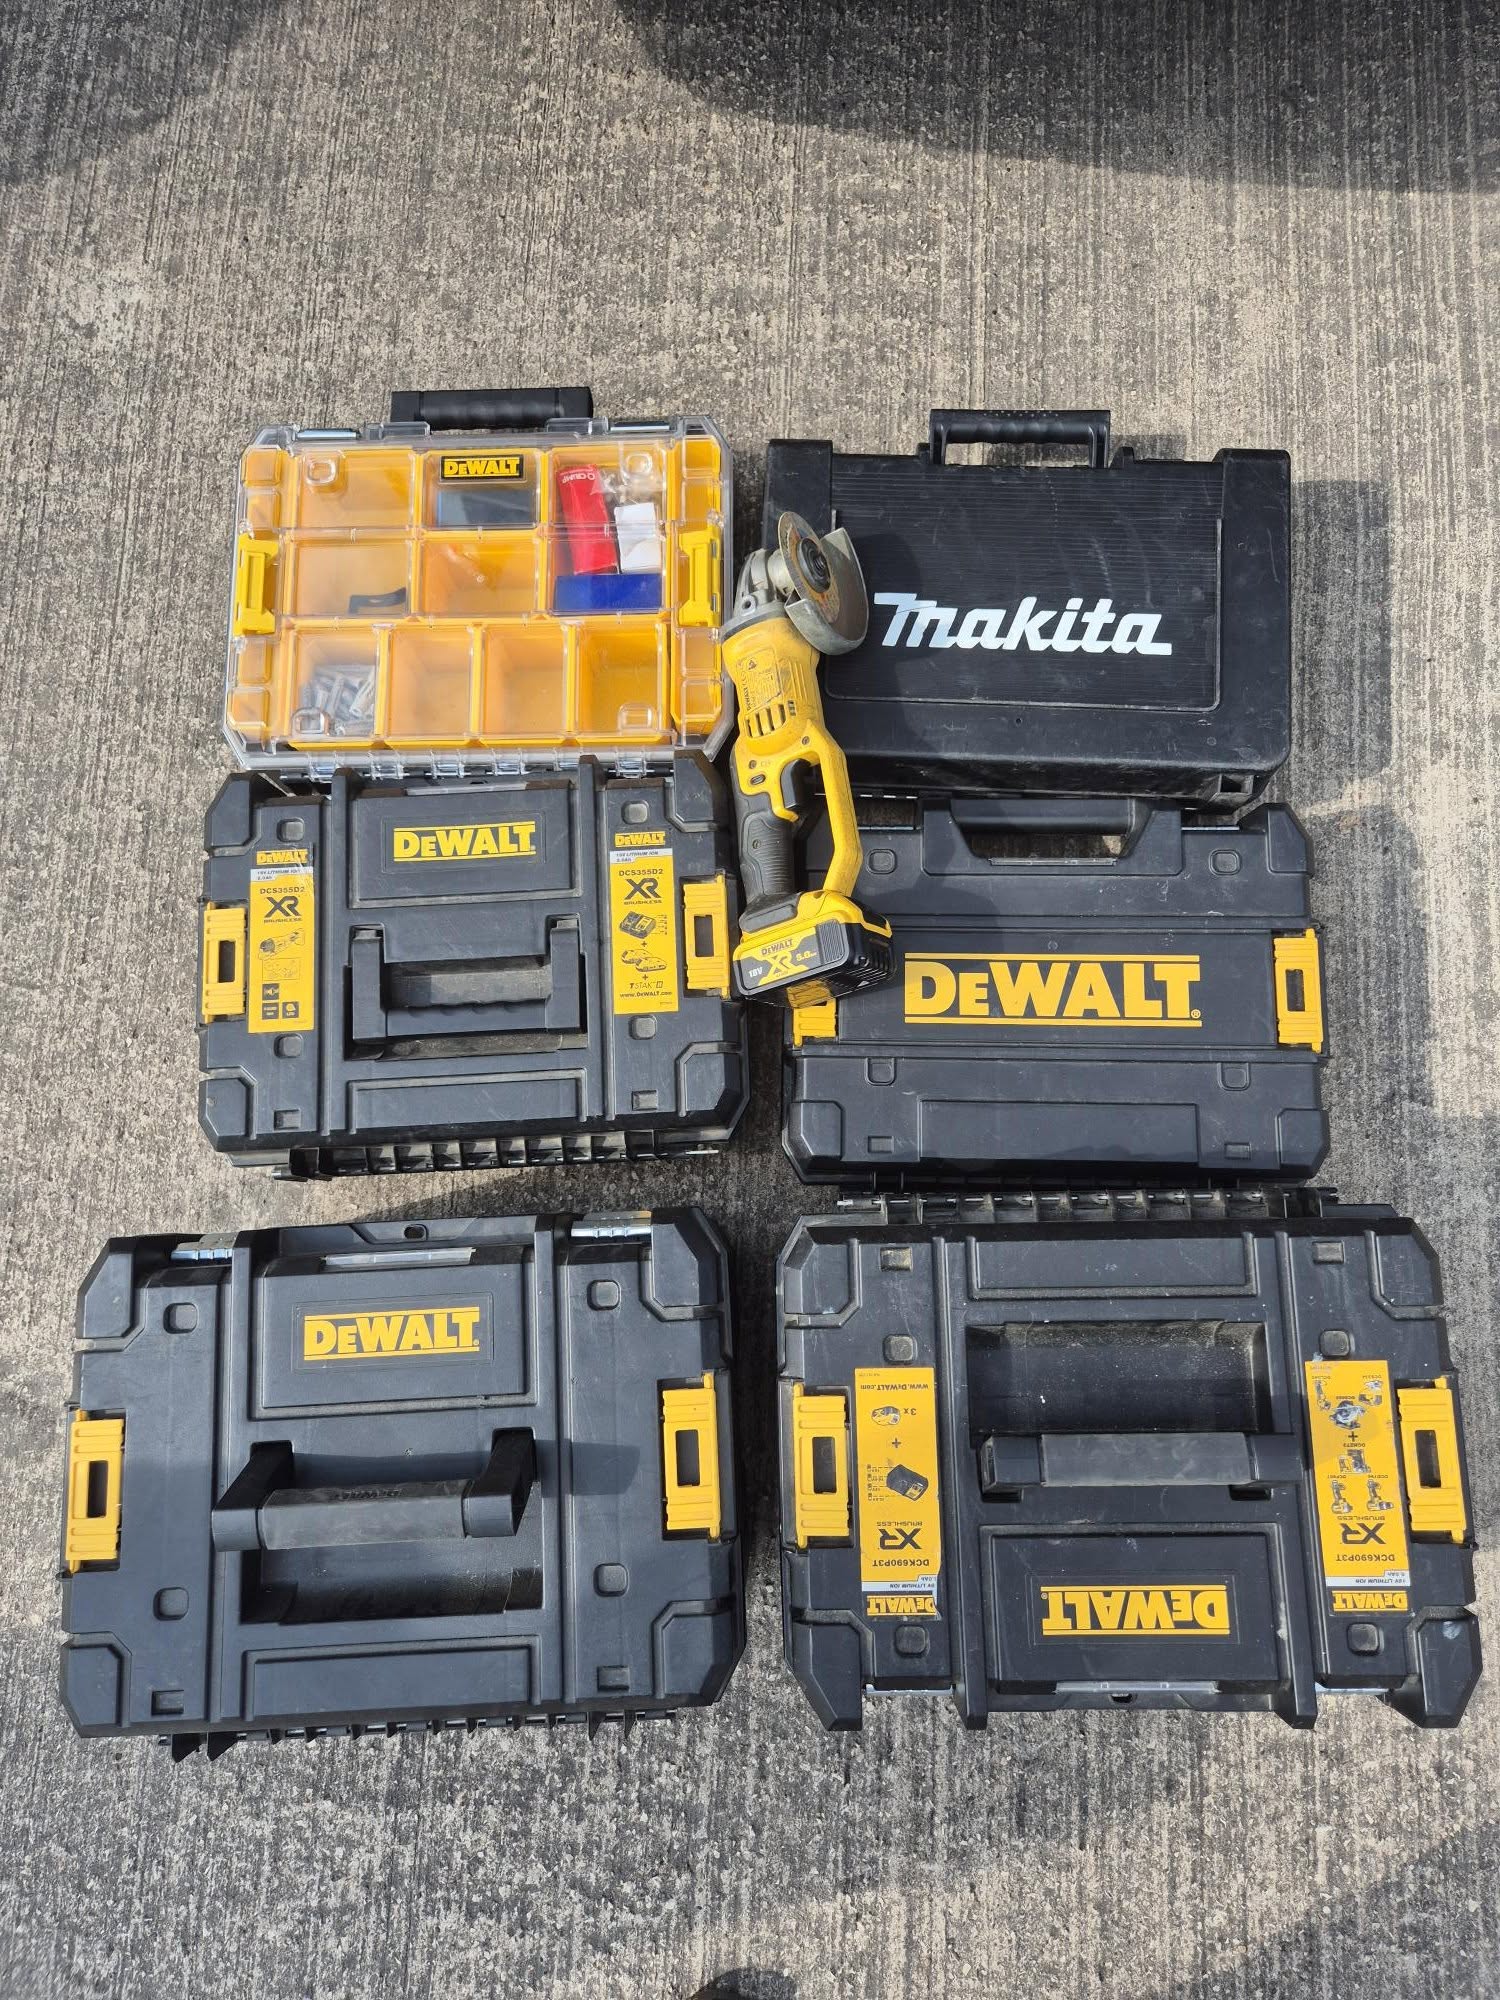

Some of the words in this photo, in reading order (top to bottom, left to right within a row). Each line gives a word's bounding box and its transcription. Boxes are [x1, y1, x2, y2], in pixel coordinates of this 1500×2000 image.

[444, 459, 519, 475] DEWALT
[874, 592, 1172, 655] makita
[394, 825, 535, 857] DEWALT
[615, 832, 665, 846] DEWALT
[619, 868, 663, 876] DCS355D2
[260, 886, 305, 894] DCS355D2
[624, 877, 662, 900] XR
[264, 895, 301, 918] XR
[761, 939, 793, 955] DEWALT
[748, 966, 763, 978] 18V
[904, 961, 1200, 1018] DEWALT
[304, 1311, 479, 1355] DEWALT
[878, 1528, 921, 1550] XR
[1340, 1523, 1386, 1544] XR
[867, 1597, 936, 1613] DEWALT
[1043, 1591, 1229, 1629] DEWALT
[1332, 1592, 1407, 1609] DEWALT
